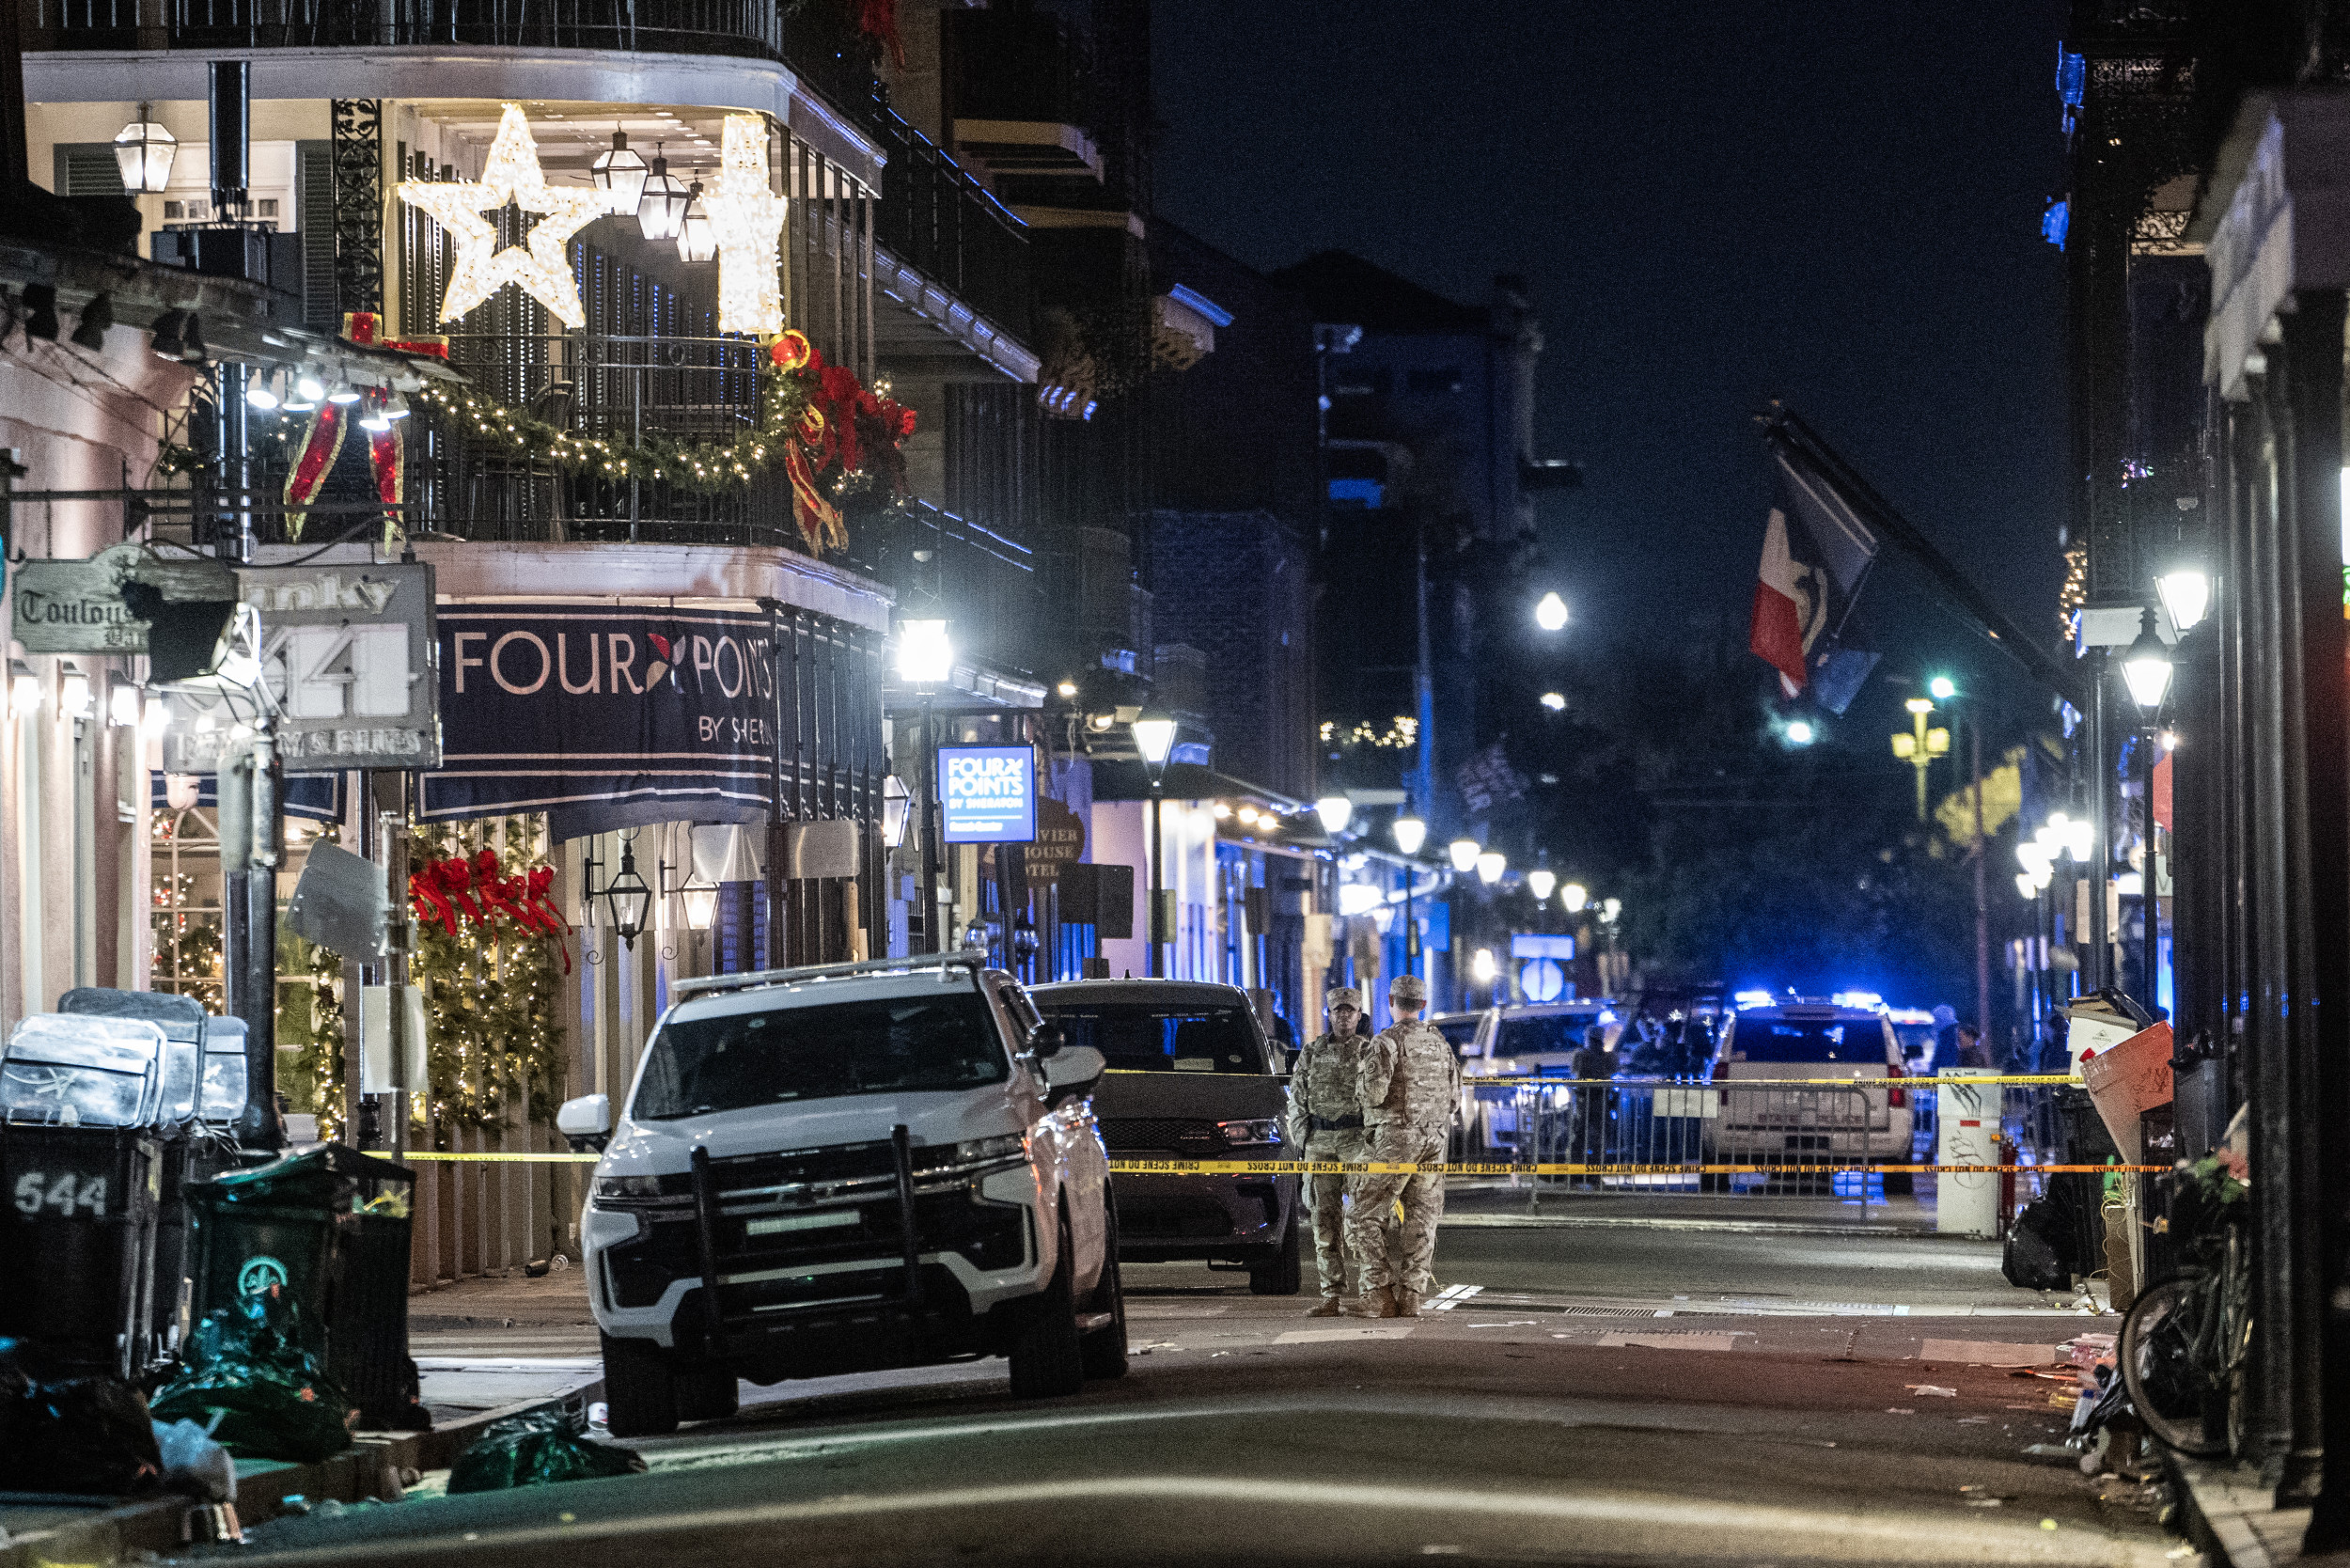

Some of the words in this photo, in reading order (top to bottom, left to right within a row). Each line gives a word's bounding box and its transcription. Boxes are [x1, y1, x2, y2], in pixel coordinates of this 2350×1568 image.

[241, 573, 401, 615] unky
[454, 630, 645, 696] FOUR
[698, 715, 725, 742] BY
[948, 757, 1005, 777] FOUR
[948, 776, 1024, 796] POINTS
[1040, 829, 1078, 842] VIER
[1026, 864, 1059, 877] TEL
[1109, 1160, 1125, 1170] NOT
[1128, 1160, 1140, 1170] DO
[1143, 1160, 1169, 1170] SCENE
[1172, 1160, 1199, 1170] CRIME
[1247, 1161, 1276, 1170] CROSS
[1277, 1162, 1293, 1171] NOT
[1297, 1162, 1308, 1171] DO
[1311, 1162, 1339, 1171] SCENE
[1341, 1163, 1369, 1172] CRIME
[1416, 1164, 1444, 1173] CROSS
[1447, 1164, 1463, 1173] NOT
[1465, 1164, 1478, 1173] DO
[1480, 1164, 1507, 1173] SCENE
[1511, 1164, 1537, 1173] CRIME
[1585, 1165, 1613, 1173] CROSS
[1616, 1165, 1632, 1173] NOT
[1635, 1165, 1647, 1173] DO
[1649, 1165, 1676, 1173] SCENE
[1679, 1165, 1706, 1173] CRIME
[15, 1171, 107, 1216] 544
